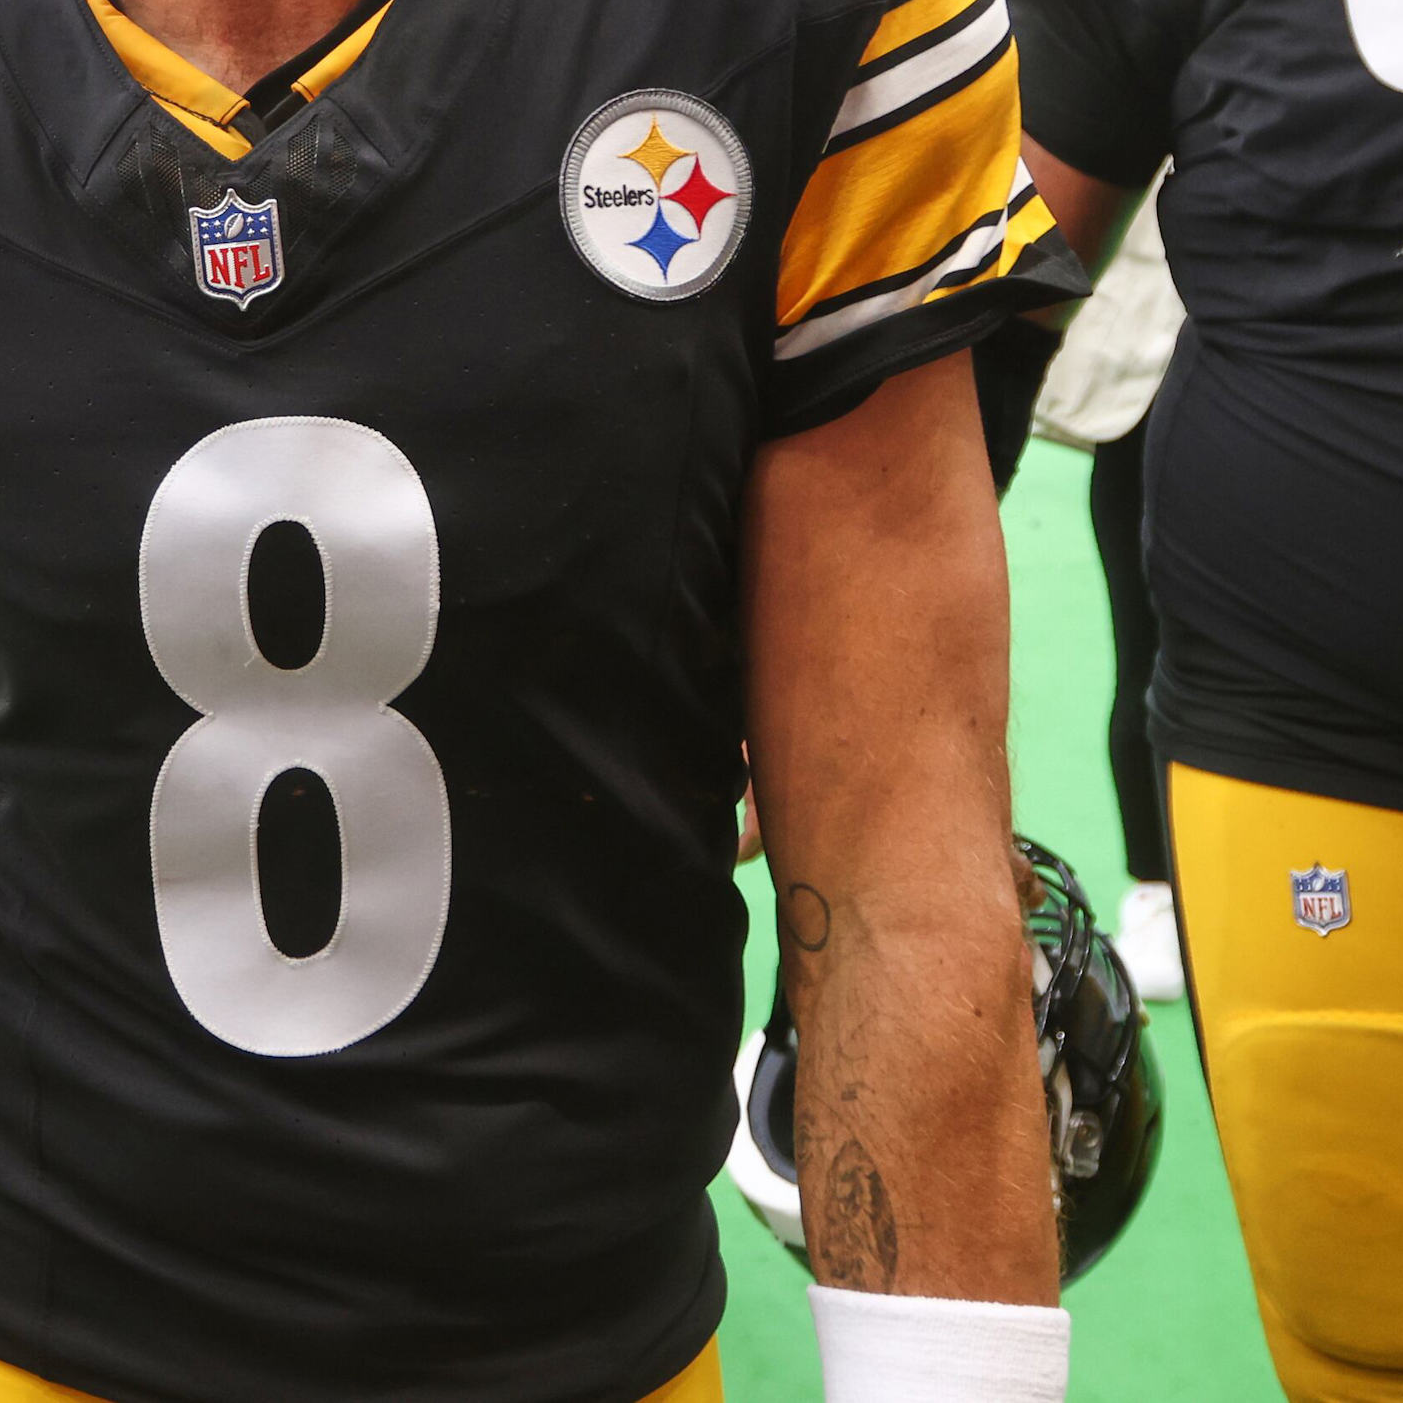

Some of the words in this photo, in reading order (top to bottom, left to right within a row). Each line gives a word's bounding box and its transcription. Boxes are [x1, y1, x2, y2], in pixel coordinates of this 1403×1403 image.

[583, 184, 655, 209] Steelers
[207, 244, 271, 289] NFL
[138, 415, 453, 1058] 8
[1302, 897, 1342, 920] NFL
